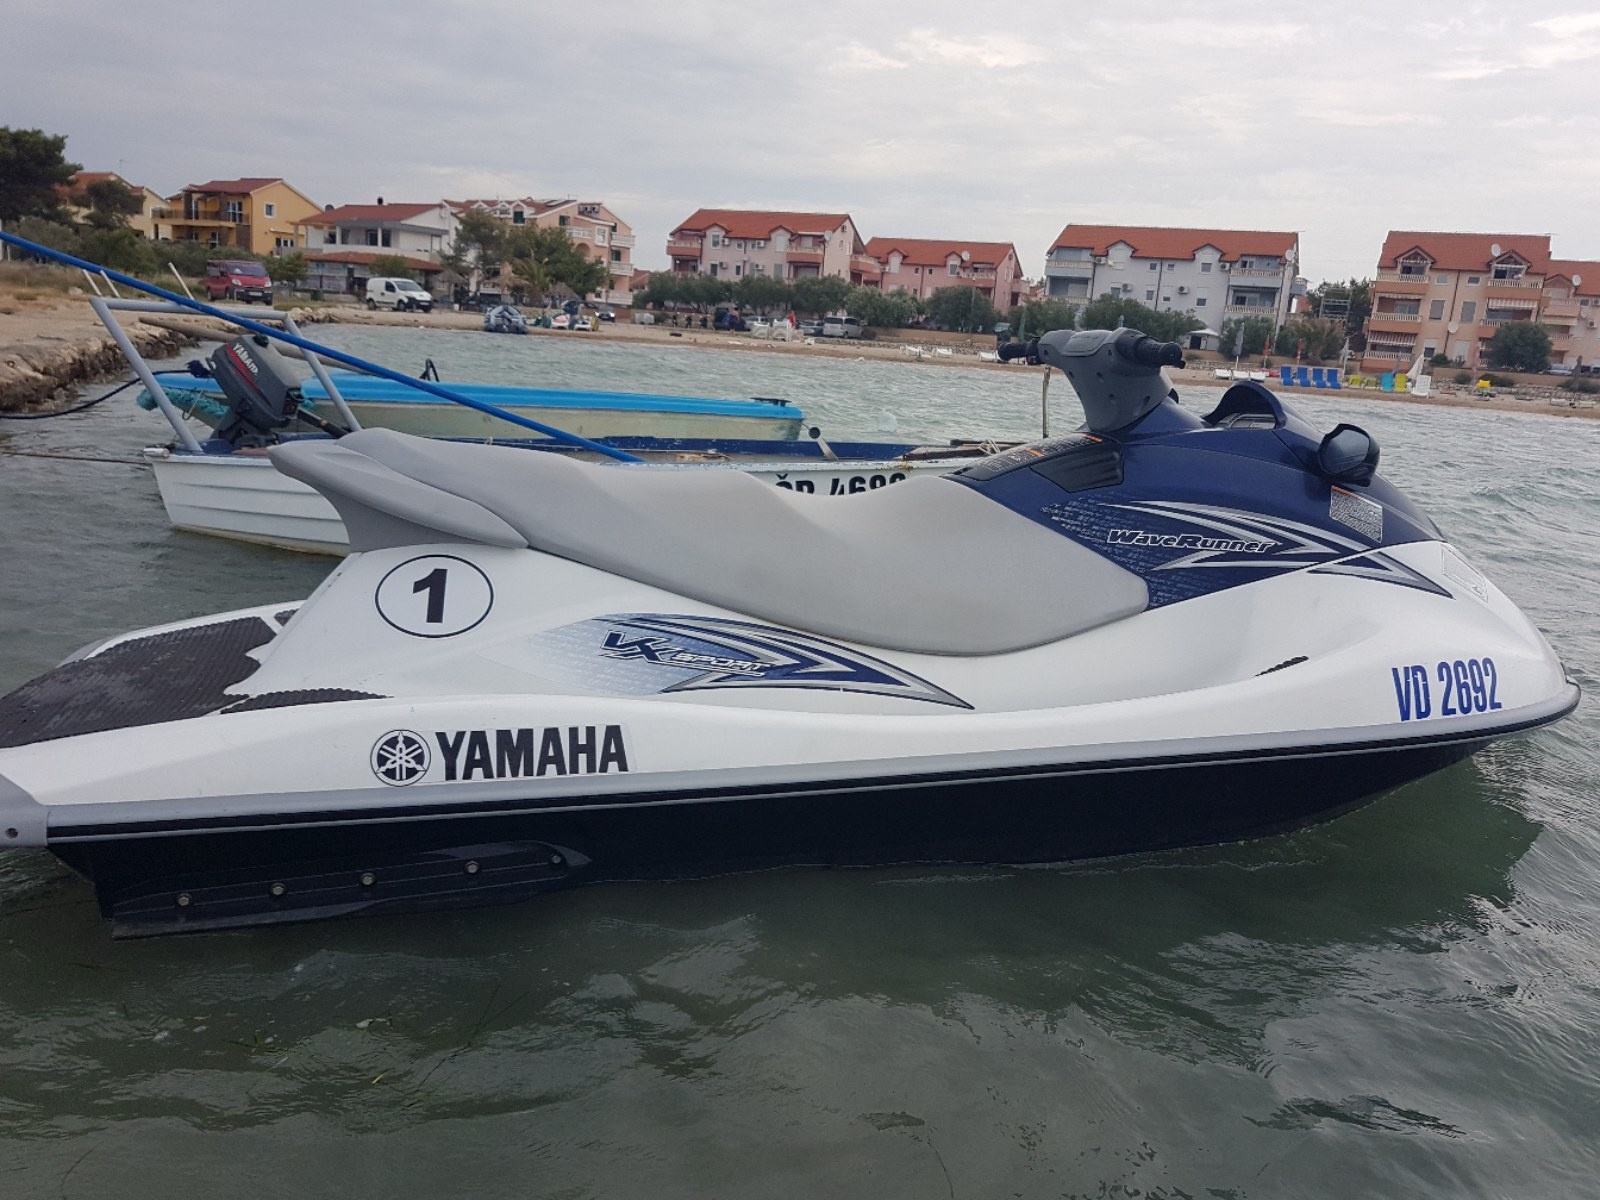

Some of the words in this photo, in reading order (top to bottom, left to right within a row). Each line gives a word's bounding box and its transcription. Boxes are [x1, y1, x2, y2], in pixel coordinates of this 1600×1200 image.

[1107, 528, 1277, 552] WaveRunner
[413, 569, 448, 623] 1
[599, 630, 676, 662] VX
[669, 650, 771, 672] SPORT
[1392, 665, 1431, 721] VD
[1437, 657, 1502, 716] 2692
[435, 725, 629, 781] YAMAHA
